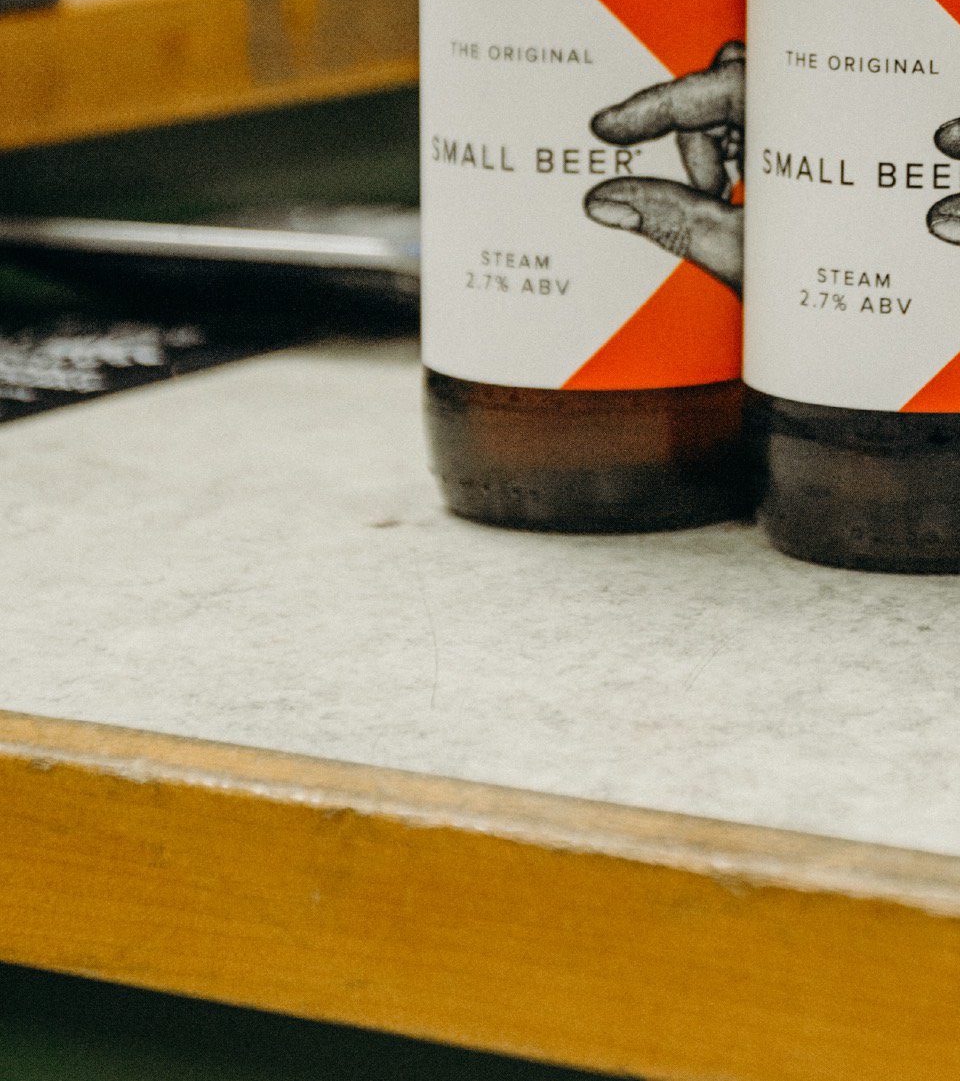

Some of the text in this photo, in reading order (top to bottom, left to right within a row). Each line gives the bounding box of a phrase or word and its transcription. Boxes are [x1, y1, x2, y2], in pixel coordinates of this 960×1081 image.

[451, 41, 594, 65] THE ORIGINAL
[786, 50, 939, 75] THE ORIGINAL
[433, 136, 515, 173] SMALL
[763, 148, 855, 187] SMALL
[482, 250, 550, 270] STEAM
[466, 271, 570, 296] 2.7% ABV
[817, 267, 891, 288] STEAM
[799, 288, 912, 315] 2.7% ABV
